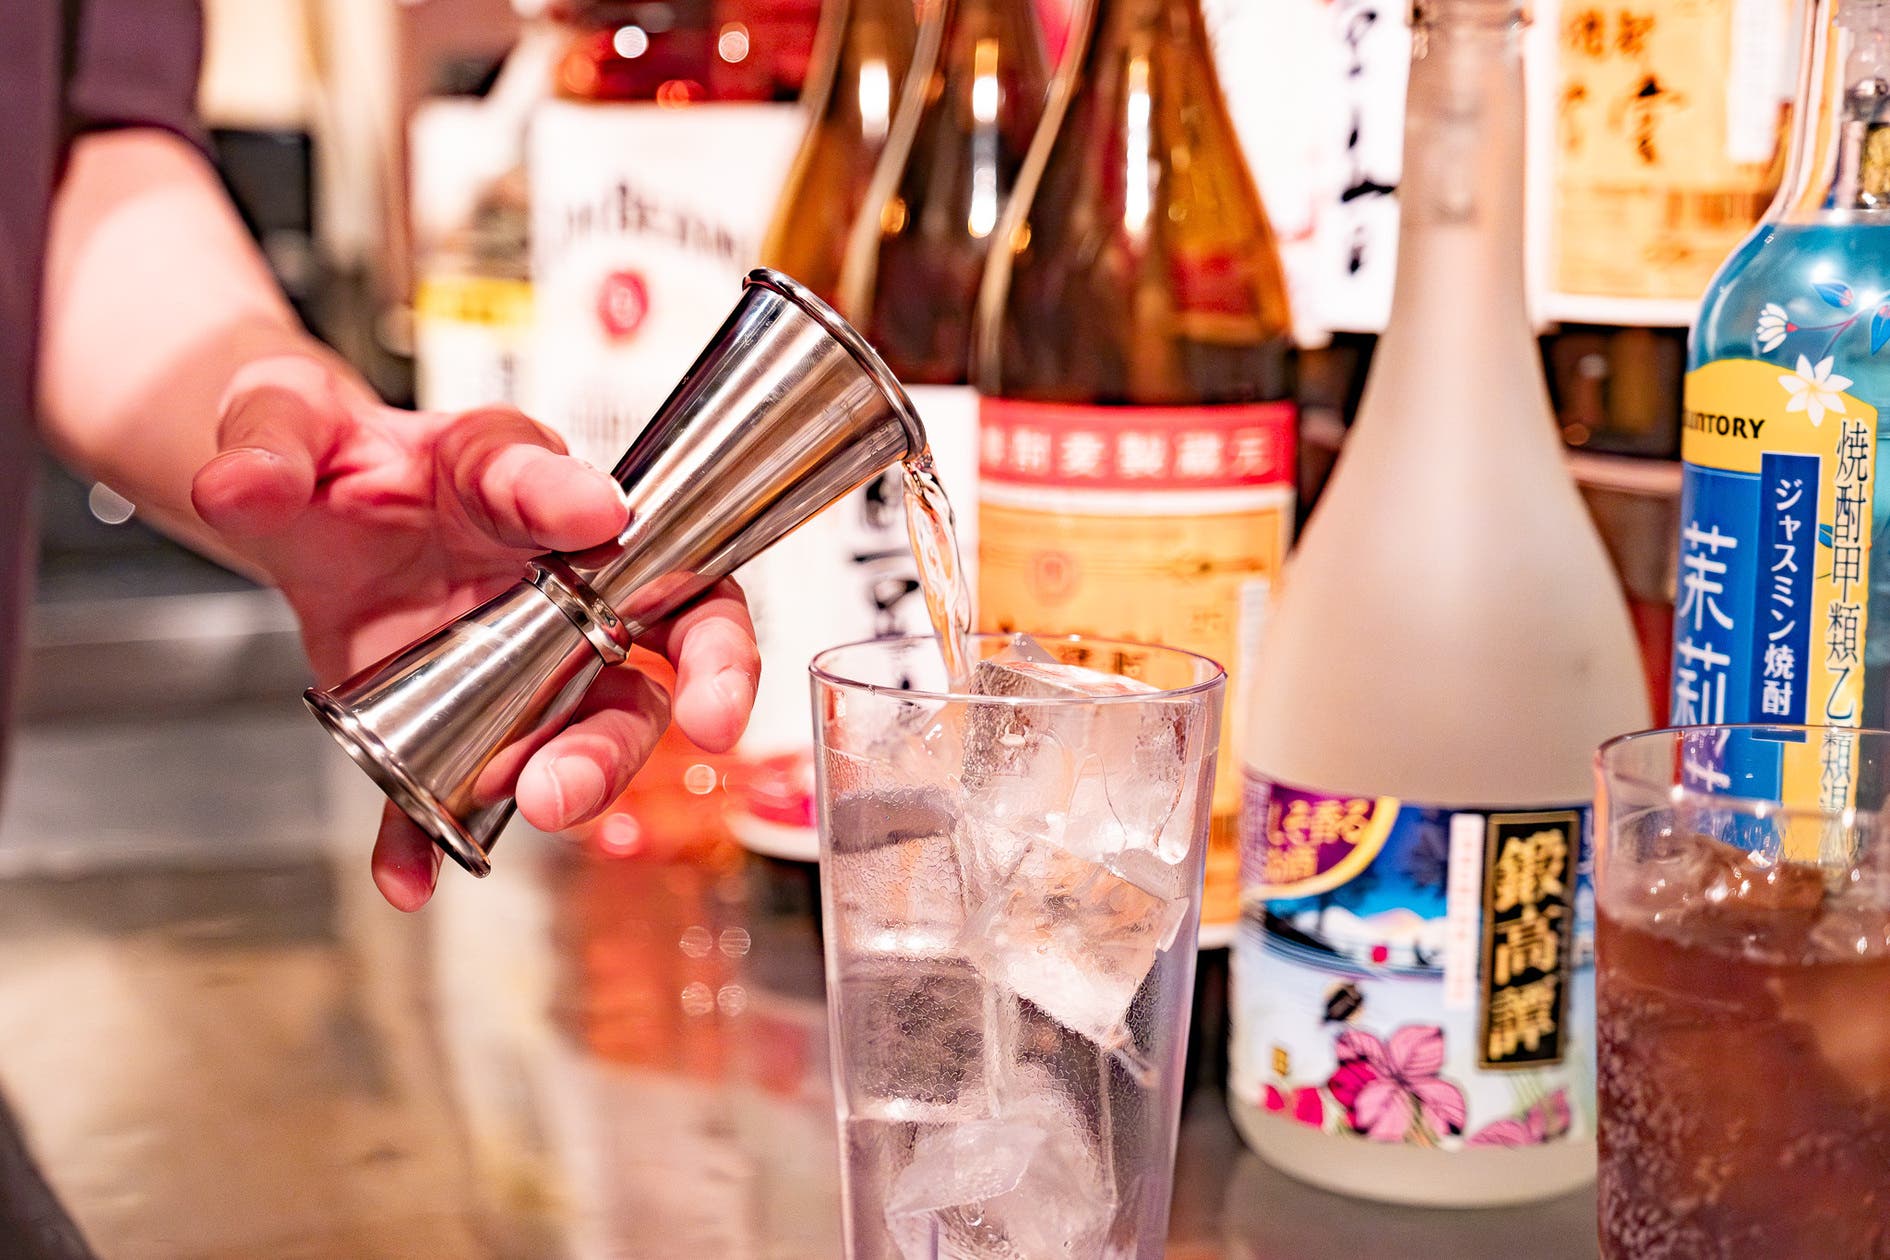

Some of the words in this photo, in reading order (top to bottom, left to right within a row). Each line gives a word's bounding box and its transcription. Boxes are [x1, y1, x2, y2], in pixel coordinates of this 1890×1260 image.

[1684, 408, 1765, 440] NTORY
[1761, 479, 1803, 716] ジャスミン焼酎
